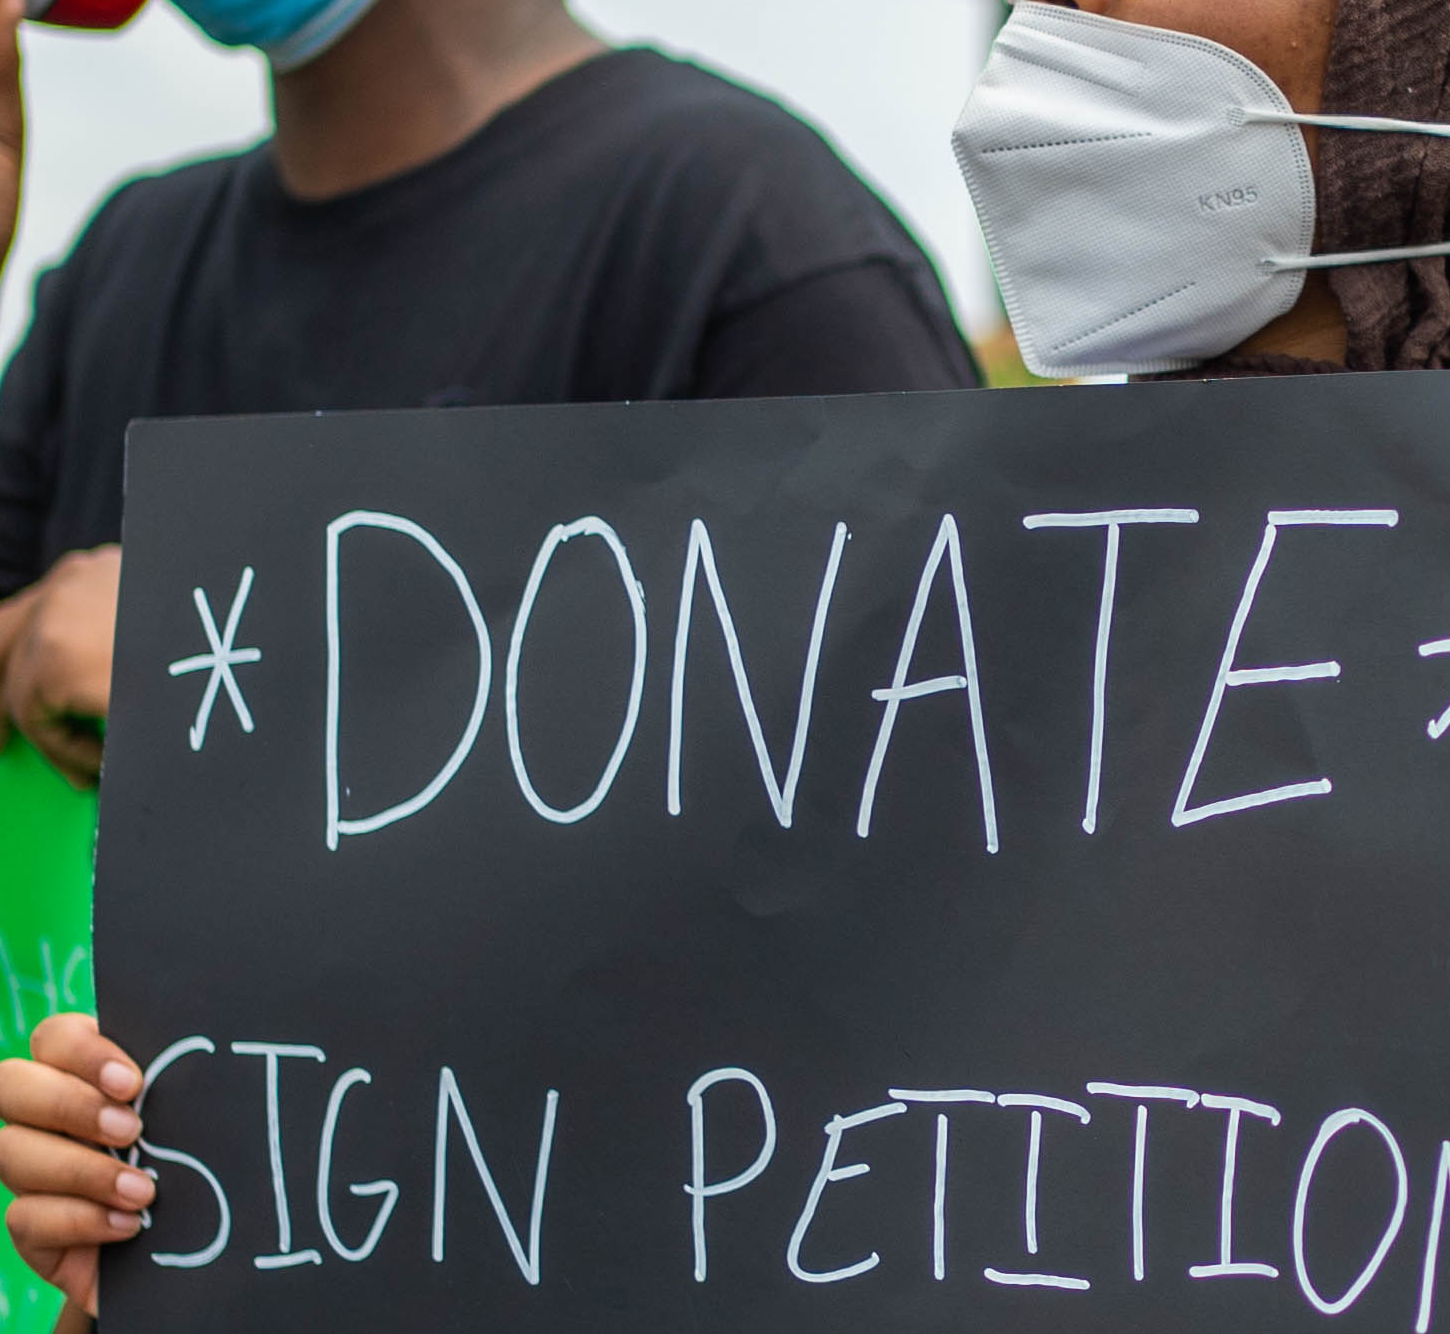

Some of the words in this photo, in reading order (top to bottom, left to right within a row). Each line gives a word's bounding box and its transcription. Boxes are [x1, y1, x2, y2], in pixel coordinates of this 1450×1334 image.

[1198, 186, 1258, 211] KN95
[327, 509, 1400, 854] DONATE
[135, 1041, 558, 1285] SIGN
